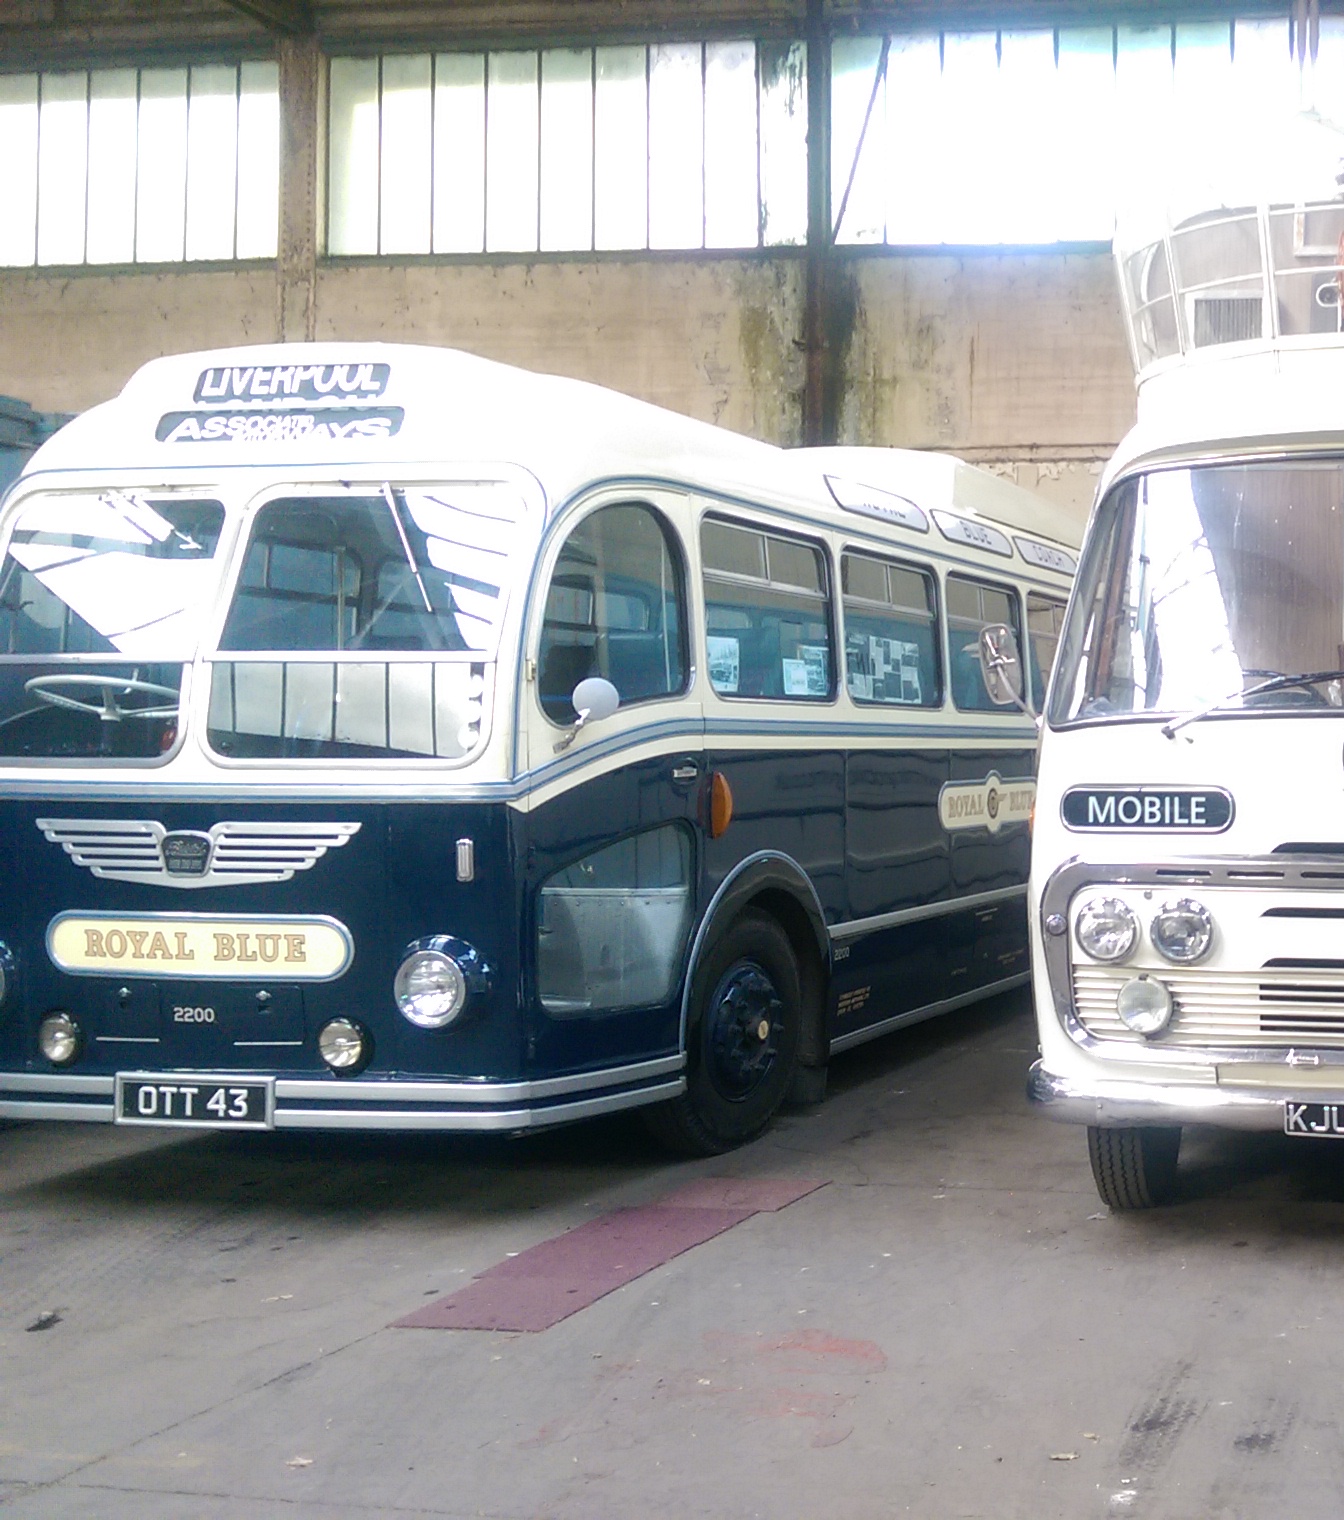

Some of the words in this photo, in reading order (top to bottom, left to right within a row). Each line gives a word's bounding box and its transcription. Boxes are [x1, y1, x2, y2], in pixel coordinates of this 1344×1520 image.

[200, 364, 382, 397] LIVERPOOL
[948, 793, 984, 819] ROYAL
[1087, 795, 1207, 824] MOBILE
[84, 928, 195, 960] ROYAL
[213, 932, 307, 963] BLUE
[173, 1006, 216, 1023] 2200
[138, 1085, 199, 1117] OTT
[206, 1087, 249, 1118] 43
